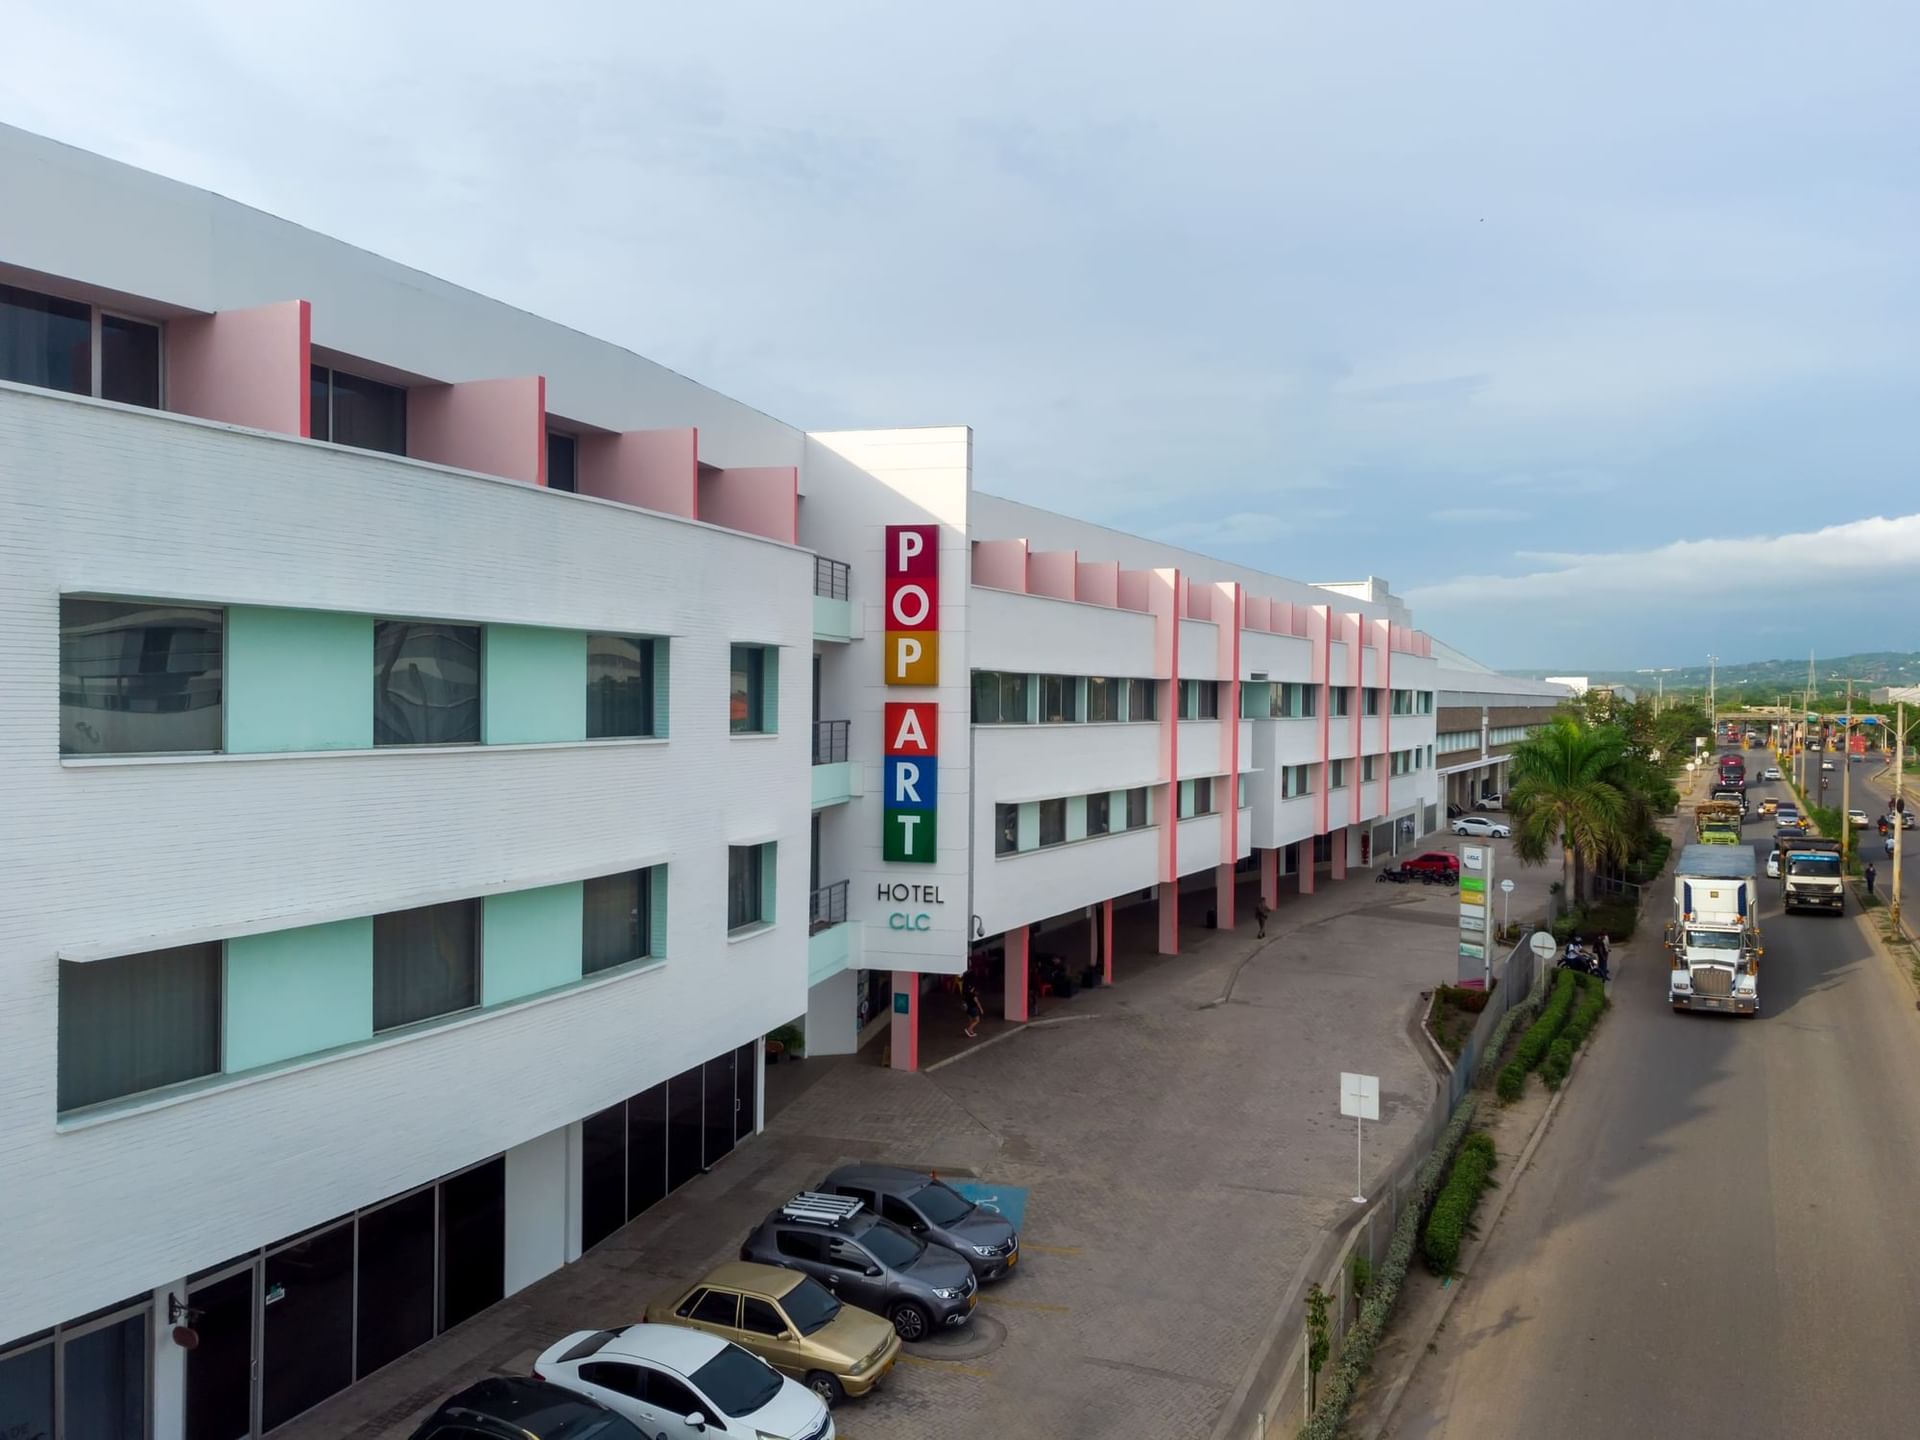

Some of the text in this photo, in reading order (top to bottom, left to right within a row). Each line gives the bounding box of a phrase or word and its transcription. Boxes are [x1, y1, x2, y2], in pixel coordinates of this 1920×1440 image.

[892, 531, 930, 856] POP ART
[878, 883, 944, 904] HOTEL
[889, 912, 930, 931] CLC
